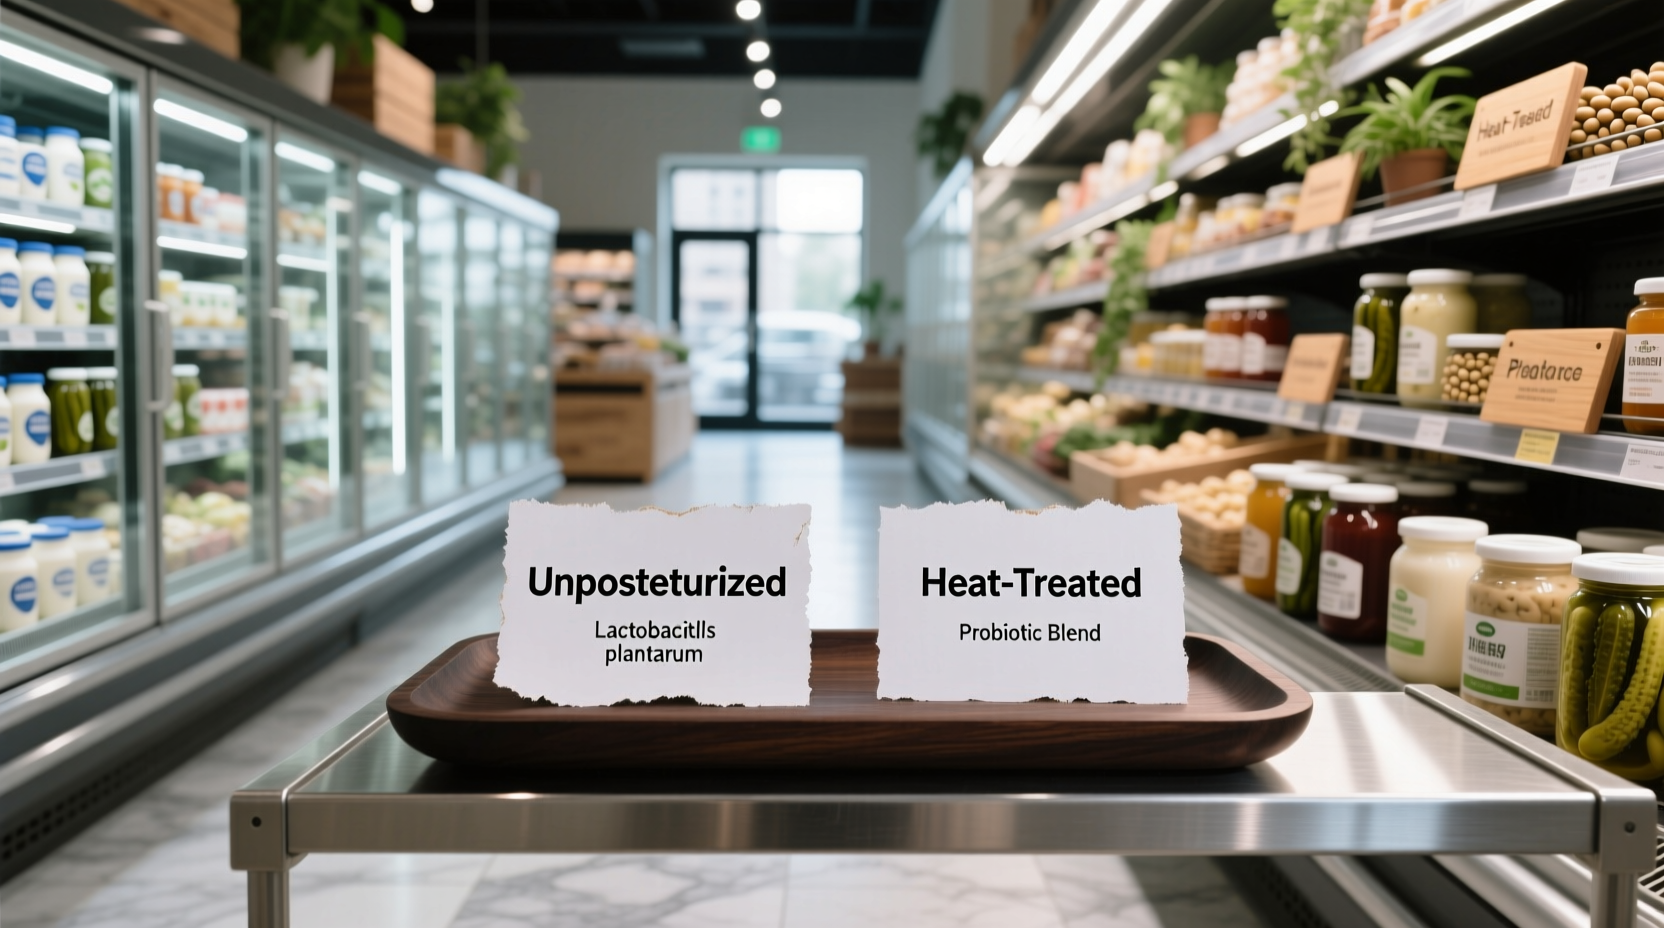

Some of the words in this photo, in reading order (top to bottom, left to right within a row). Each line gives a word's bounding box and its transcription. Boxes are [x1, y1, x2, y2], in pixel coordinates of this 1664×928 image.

[528, 565, 787, 605] Unposteturized
[922, 567, 1142, 598] Heat-Treated
[959, 622, 1042, 642] Probiotic
[1048, 622, 1101, 642] Blend
[605, 643, 703, 667] plantarum
